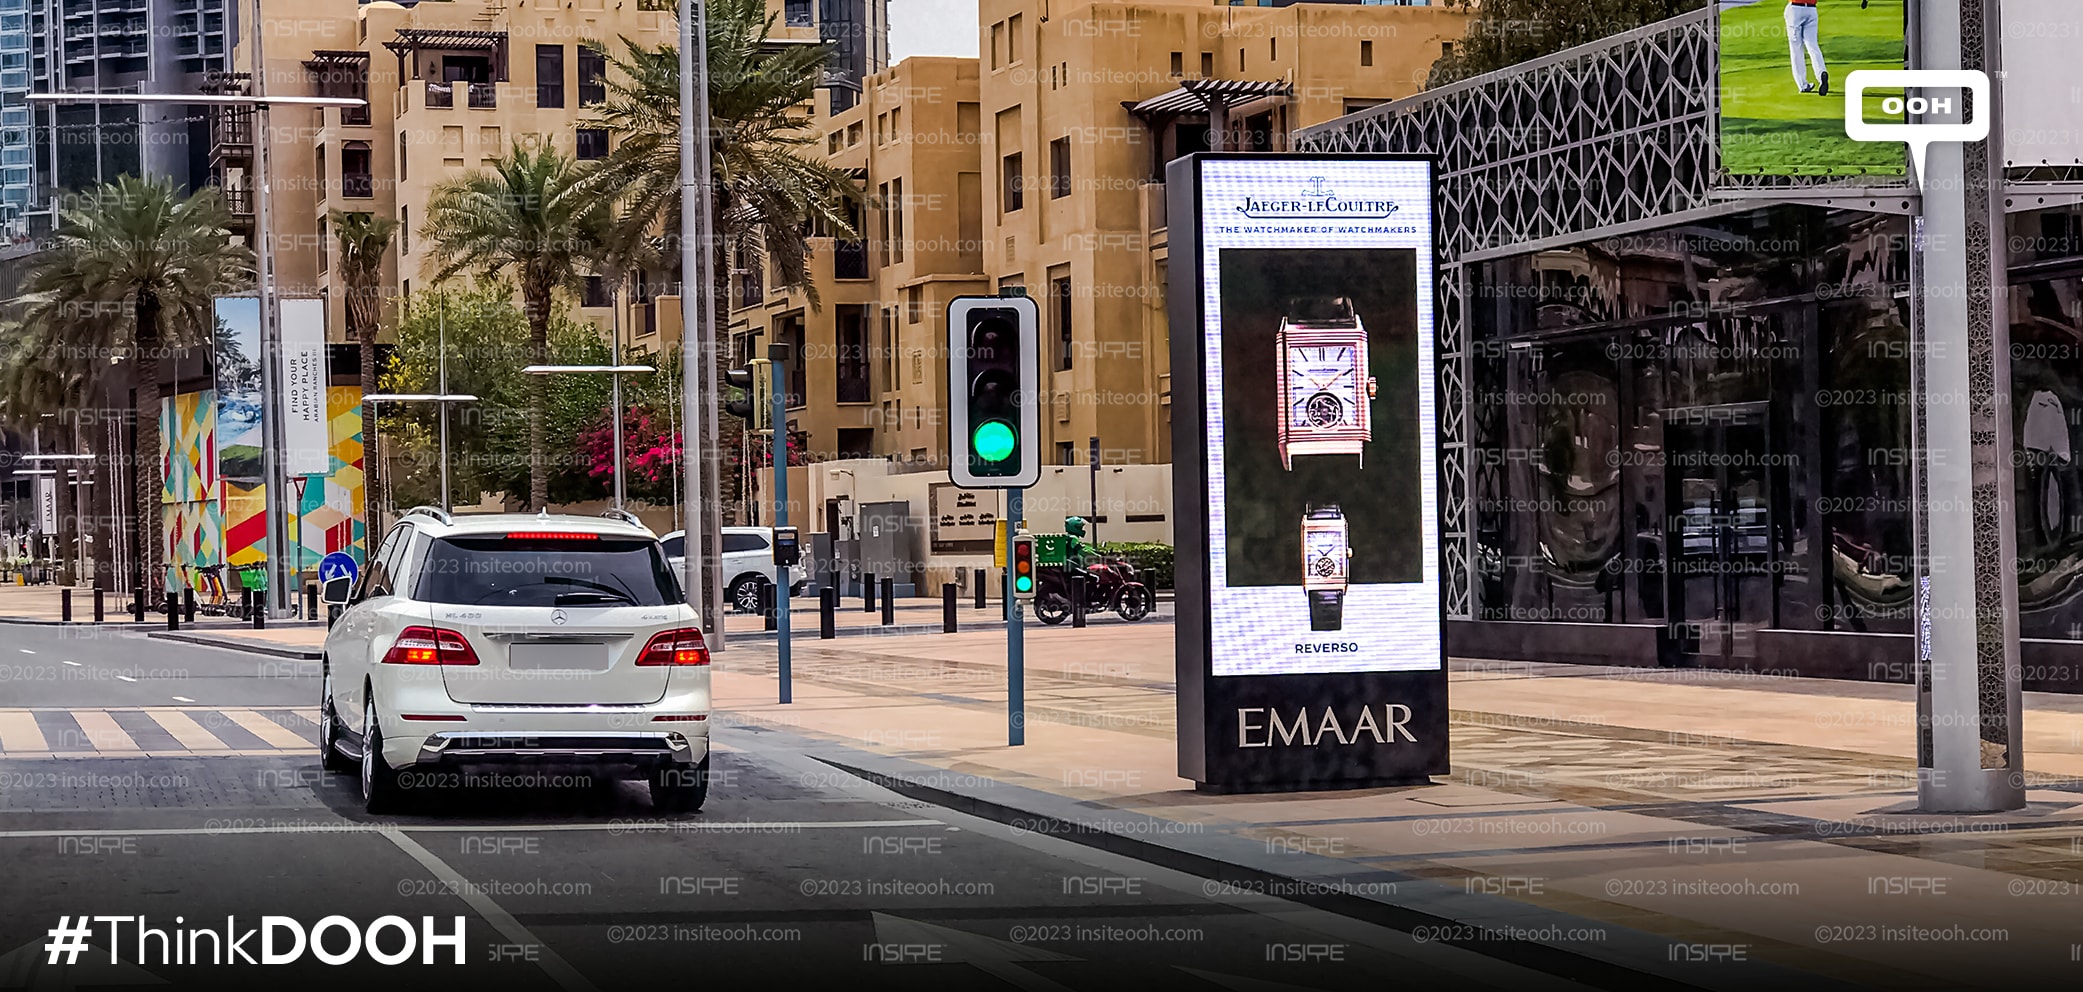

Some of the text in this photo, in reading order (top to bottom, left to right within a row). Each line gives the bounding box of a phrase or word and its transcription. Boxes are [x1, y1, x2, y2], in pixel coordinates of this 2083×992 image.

[1219, 226, 1417, 234] THE WATCHMAKER OF WATCHMAKERS
[290, 359, 298, 386] YOUR
[301, 351, 310, 420] HAPPY PLACE
[1295, 642, 1358, 654] REVERSO
[1238, 703, 1417, 748] EMAAR
